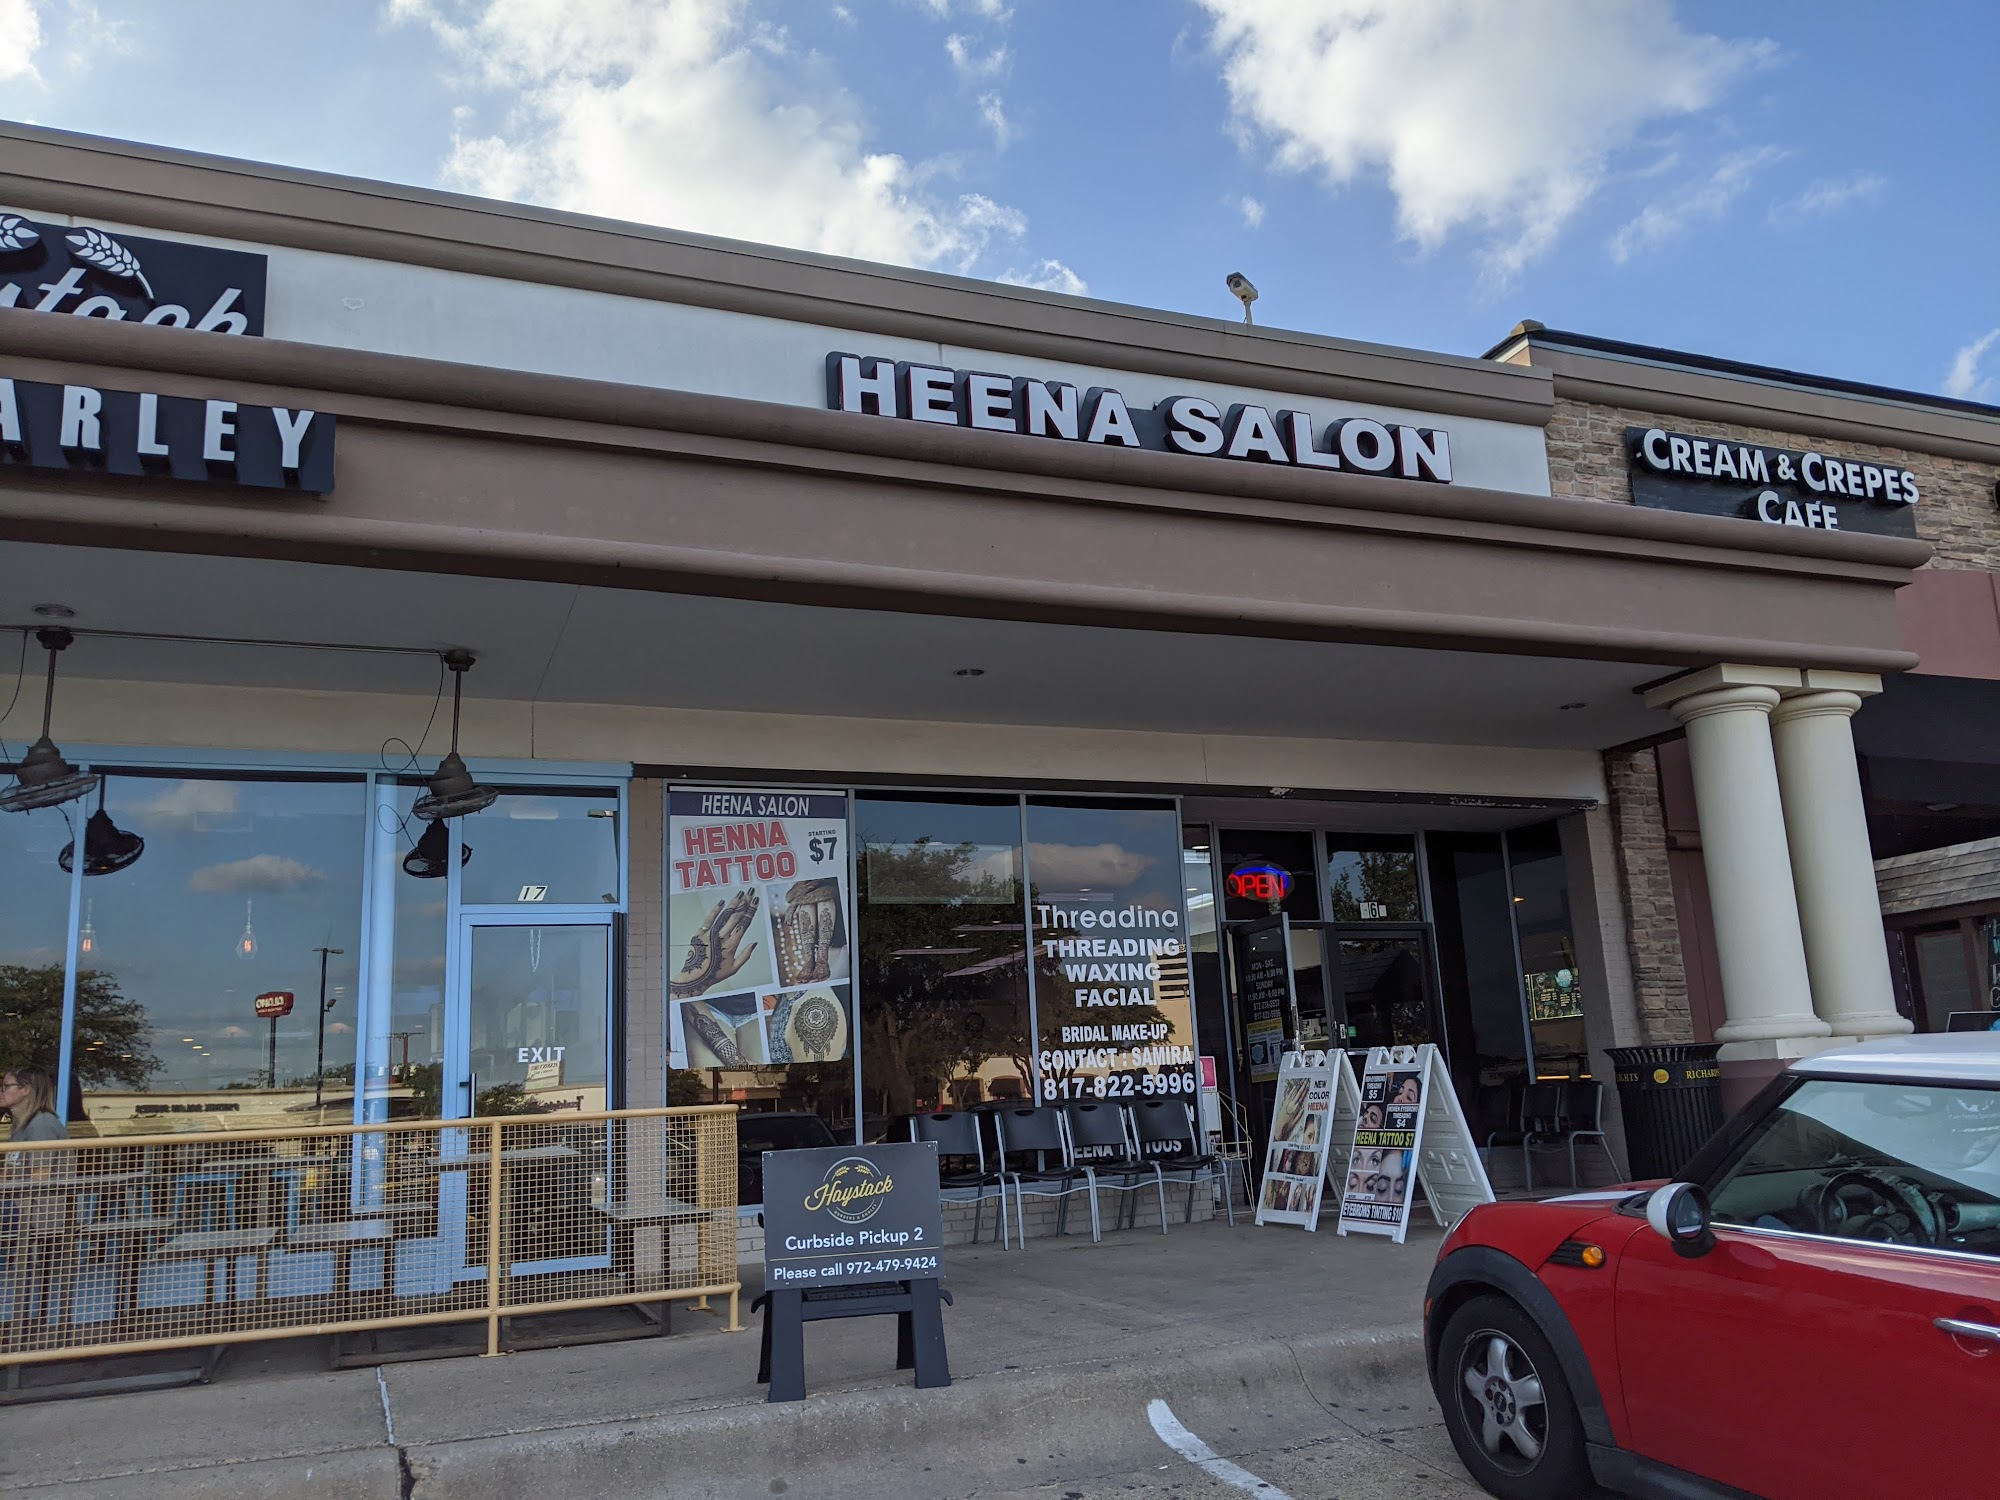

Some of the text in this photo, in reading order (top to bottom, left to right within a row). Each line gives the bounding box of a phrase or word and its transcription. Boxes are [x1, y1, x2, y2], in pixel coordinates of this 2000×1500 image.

[838, 355, 1453, 484] HEENA SALON
[1643, 428, 1920, 504] CREAM & CREPES
[701, 794, 810, 817] HEENA SALON
[684, 820, 789, 856] HENNA
[808, 829, 836, 837] STARTING
[808, 836, 838, 865] $7
[674, 850, 797, 890] TATTOO
[523, 886, 546, 900] 17
[1226, 872, 1285, 899] OPEN
[1042, 937, 1180, 958] THREADING
[1065, 962, 1162, 983] WAXING
[1255, 979, 1274, 990] SUNDAY
[1075, 986, 1157, 1008] FACIAL
[1061, 1023, 1168, 1043] BRIDAL MAKE-UP
[518, 1046, 566, 1063] EXIT
[1038, 1048, 1118, 1071] CONTACT
[1131, 1045, 1194, 1067] SAMIRA
[1043, 1072, 1196, 1101] 817-822-5996
[1314, 1079, 1328, 1089] NEW
[1368, 1089, 1378, 1100] $5
[1308, 1090, 1330, 1100] COLOR
[1307, 1101, 1329, 1112] HEENA
[1396, 1118, 1407, 1129] $4
[1355, 1131, 1415, 1147] HEENA TATTOO $7
[804, 1174, 894, 1212] Haystack
[1342, 1202, 1371, 1218] EYEBROWS
[1371, 1204, 1393, 1221] TINTING
[785, 1226, 924, 1251] Curbside Pickup 2
[774, 1255, 938, 1281] Please call 972-479-9424
